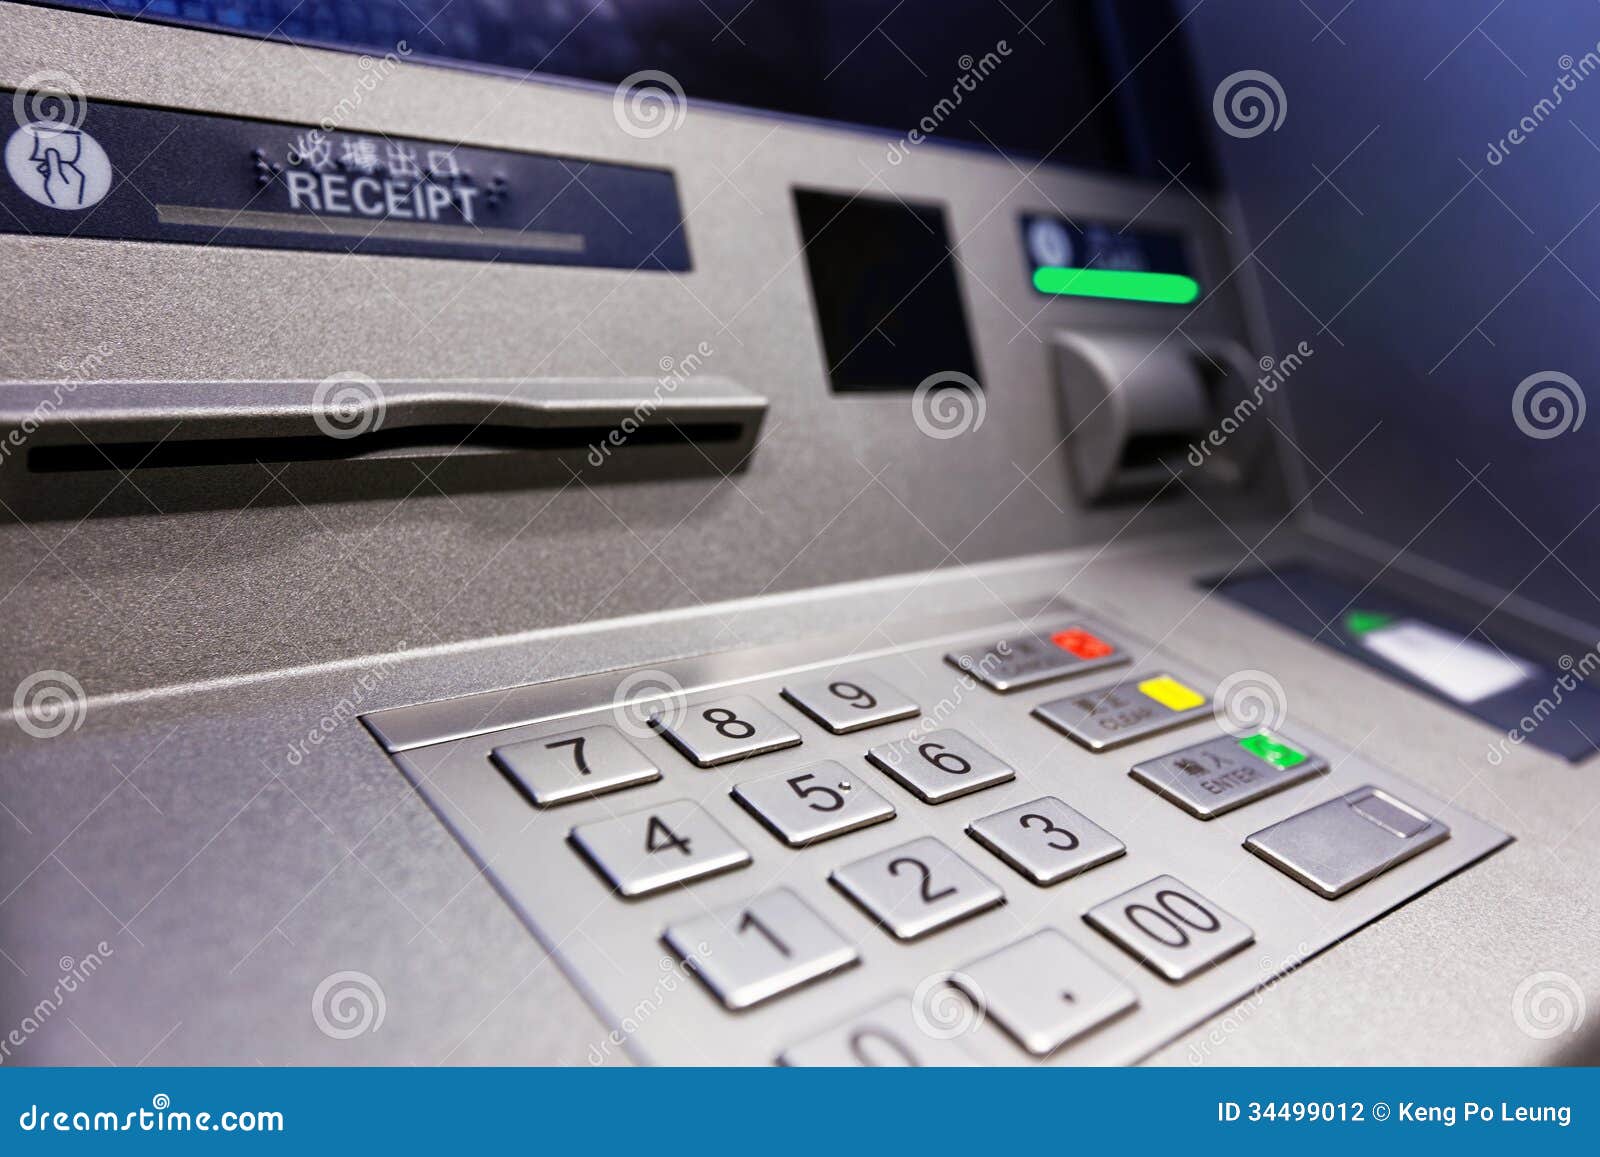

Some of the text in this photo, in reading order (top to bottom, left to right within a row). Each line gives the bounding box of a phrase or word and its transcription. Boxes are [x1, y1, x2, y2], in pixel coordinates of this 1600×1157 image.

[286, 170, 478, 223] RECEIPT
[828, 682, 877, 710] 9
[702, 708, 756, 740] 8
[545, 736, 591, 776] 7
[918, 742, 972, 775] 6
[786, 773, 845, 813] 5
[1200, 765, 1261, 795] ENTER
[645, 815, 692, 855] 4
[1019, 813, 1080, 851] 3
[888, 857, 958, 903] 2
[738, 910, 790, 958] 1
[1124, 889, 1222, 949] 00
